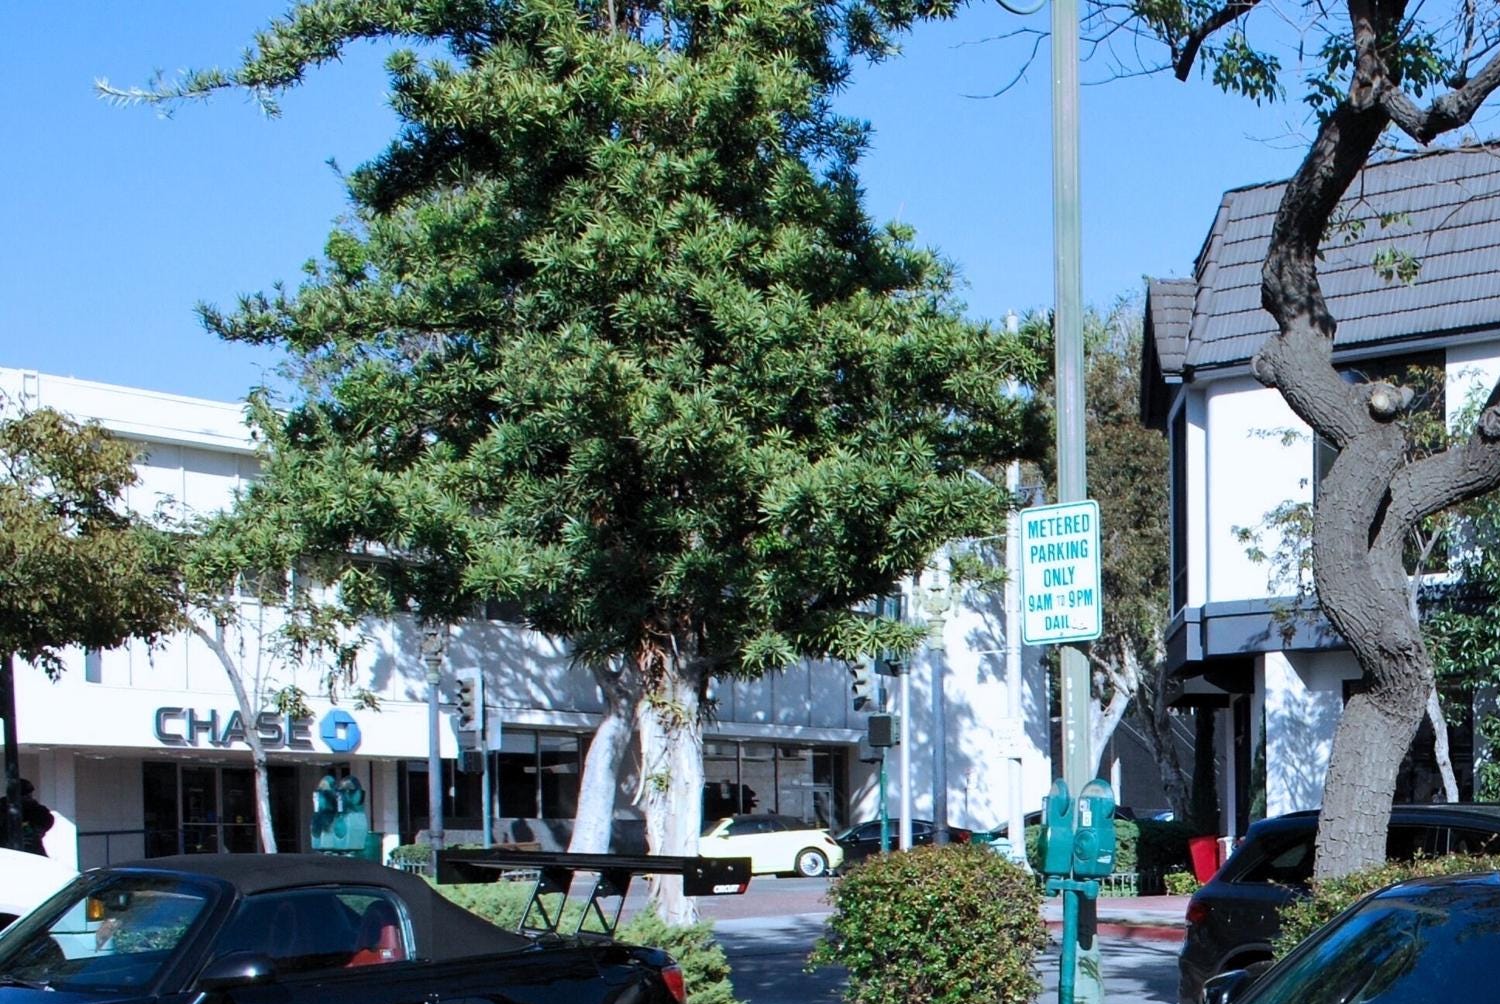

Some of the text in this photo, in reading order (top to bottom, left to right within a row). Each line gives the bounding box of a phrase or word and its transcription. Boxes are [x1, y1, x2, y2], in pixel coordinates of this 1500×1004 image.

[1028, 514, 1090, 539] METERED
[1030, 539, 1088, 564] PARKING
[1043, 566, 1075, 588] ONLY
[1028, 593, 1053, 612] 9AM
[1068, 589, 1093, 608] 9PM
[1045, 615, 1081, 630] DAIL
[154, 706, 315, 749] CHASE
